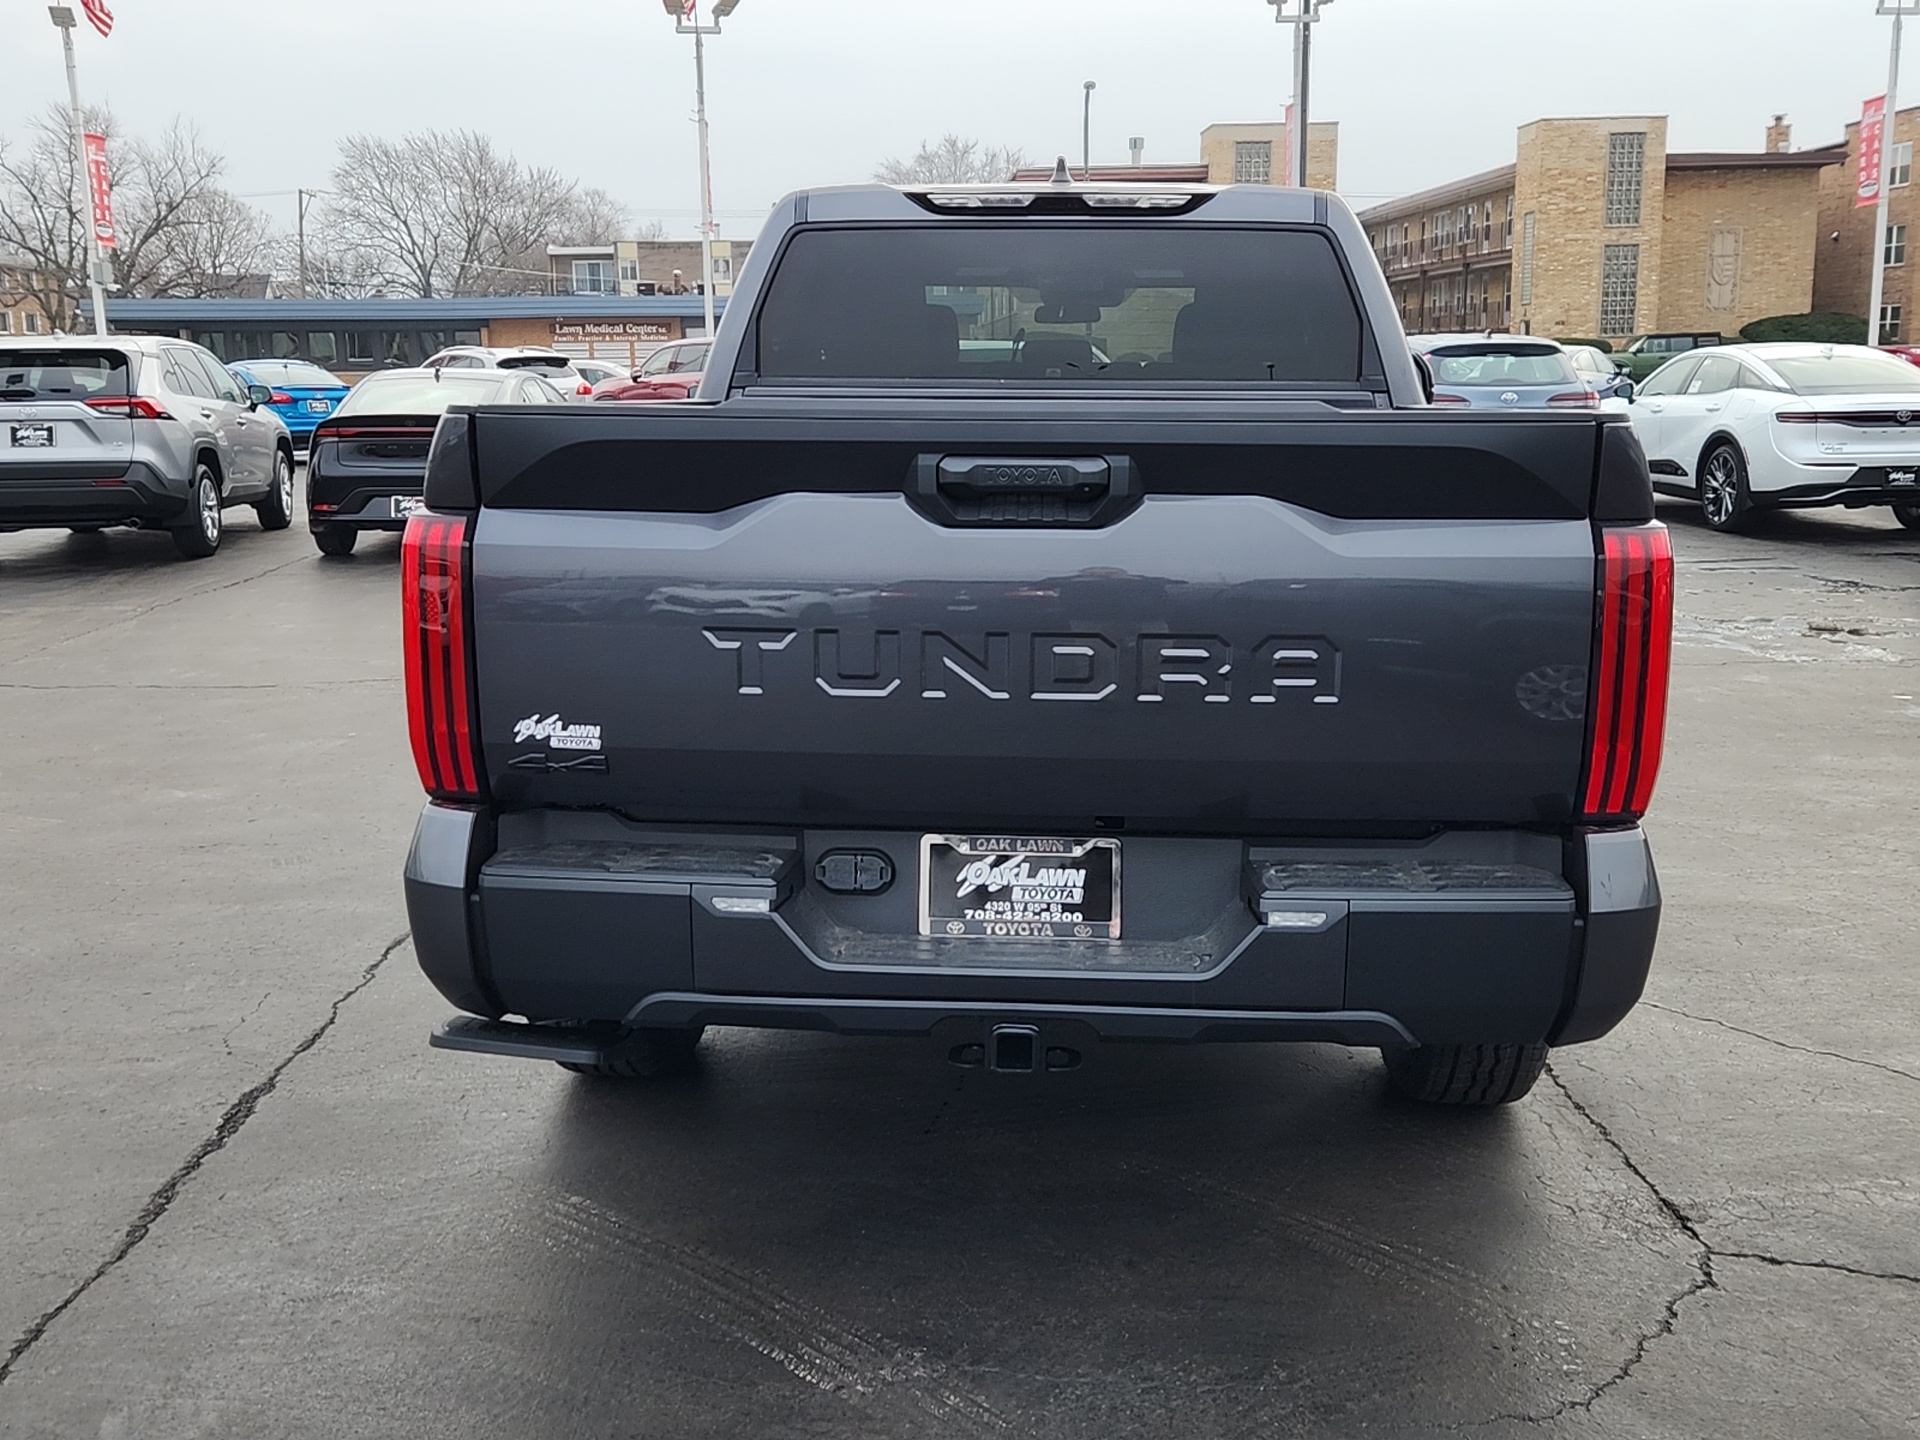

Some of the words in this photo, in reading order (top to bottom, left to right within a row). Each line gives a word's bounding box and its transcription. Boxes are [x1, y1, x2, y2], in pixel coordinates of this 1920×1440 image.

[1859, 126, 1869, 181] USED
[1871, 123, 1881, 179] CARS
[555, 323, 583, 336] Lawn
[584, 323, 624, 334] Medical
[625, 323, 658, 336] Center
[984, 467, 1063, 484] TOYOTA
[701, 627, 1343, 703] TUNDRA
[556, 738, 594, 747] TOYOTA
[976, 838, 1011, 851] OAK
[1016, 839, 1065, 853] LAWN
[1019, 887, 1076, 900] TOYOTA
[984, 901, 1011, 912] 4320
[1013, 902, 1025, 912] W
[1049, 903, 1063, 913] St
[963, 908, 1084, 923] 708-422-5200
[983, 922, 1055, 937] TOYOTA
